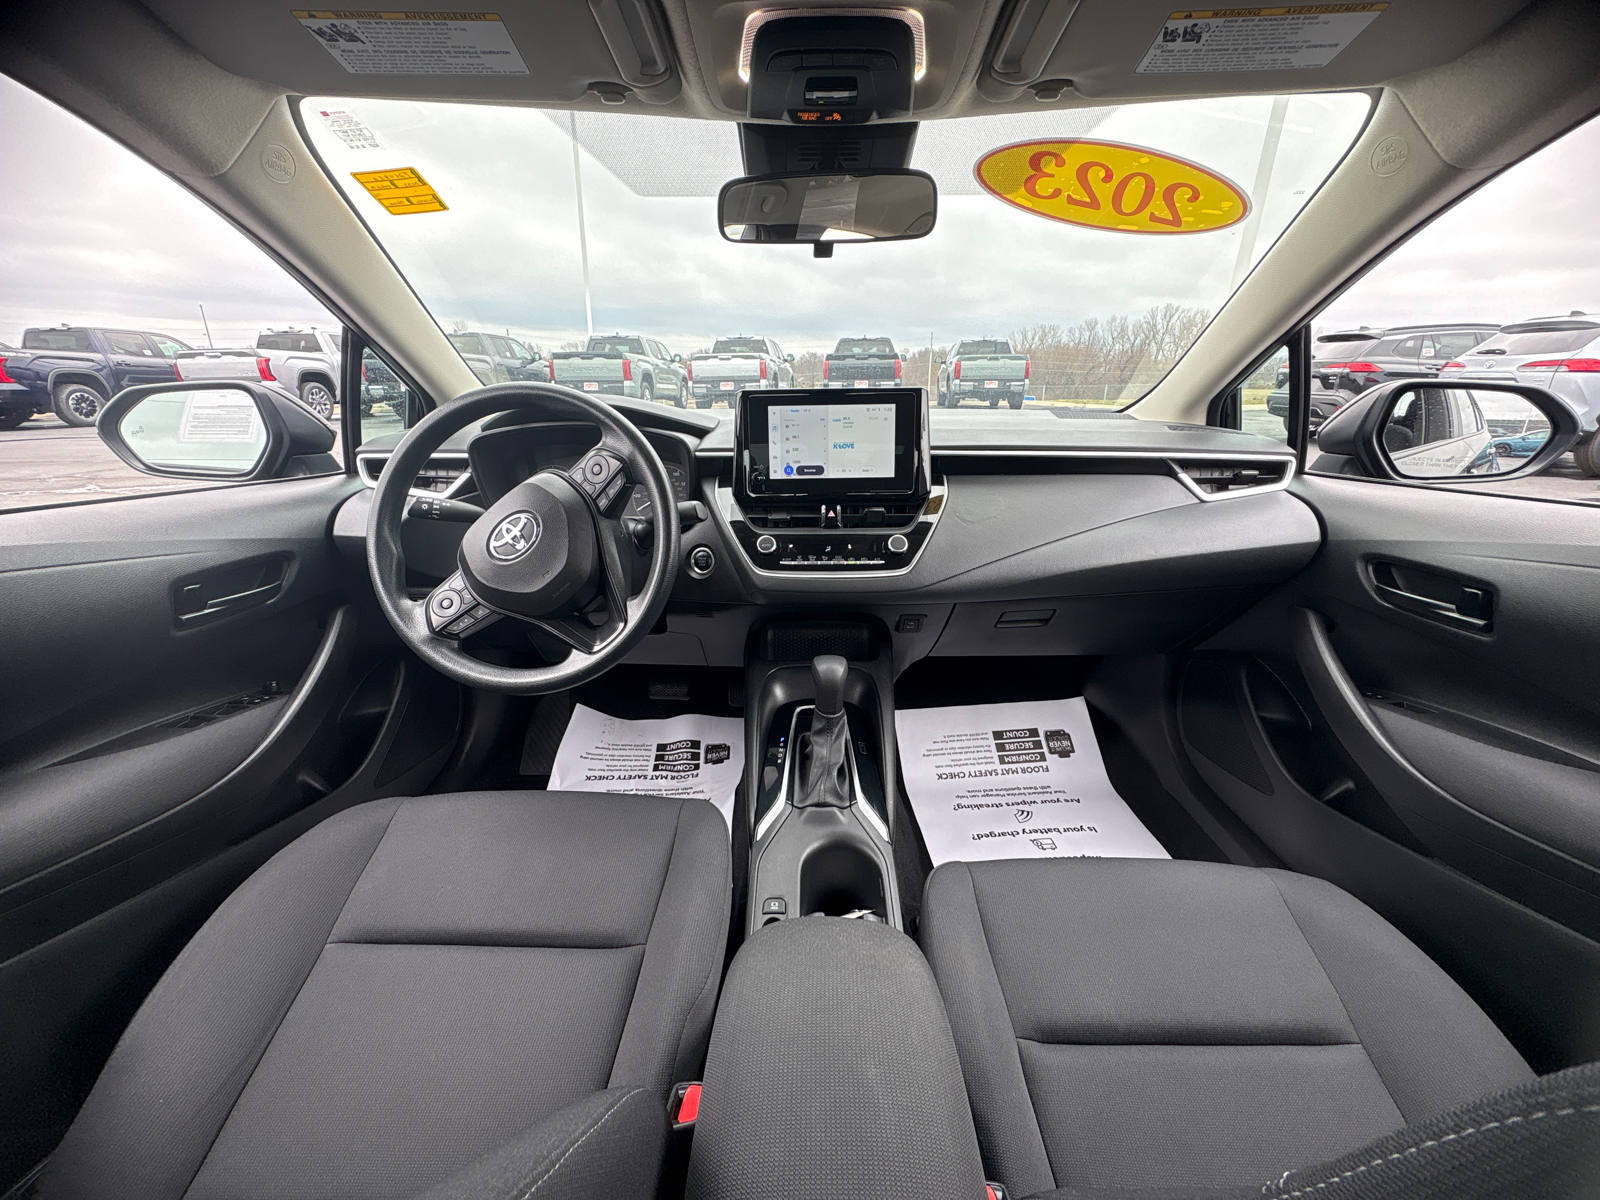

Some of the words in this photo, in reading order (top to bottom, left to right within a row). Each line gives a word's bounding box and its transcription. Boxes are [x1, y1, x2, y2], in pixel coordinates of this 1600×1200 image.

[1212, 8, 1262, 17] WARNING
[1284, 4, 1372, 14] AVERTISSEMENT
[332, 11, 383, 19] WARNING
[405, 12, 487, 20] AVERTISSEMENT
[1380, 141, 1396, 157] SRS
[272, 150, 287, 164] SRS
[1376, 149, 1405, 170] AIRBAG
[265, 158, 292, 177] AIRBAG
[568, 365, 608, 373] TUNDRA
[1002, 730, 1030, 738] COUNT
[665, 741, 692, 750] COUNT
[1004, 742, 1034, 750] SECURE
[1049, 740, 1071, 748] NEVER
[663, 752, 692, 761] SECURE
[706, 751, 728, 759] NEVER
[1004, 753, 1040, 762] CONFIRM
[967, 769, 999, 778] SAFETY
[1000, 767, 1019, 776] MAT
[1019, 765, 1050, 774] FLOOR
[670, 772, 699, 780] FLOOR
[936, 771, 966, 781] CHECK
[1005, 799, 1039, 807] wipers
[1040, 797, 1061, 805] your
[953, 802, 1004, 811] streaking?
[1021, 826, 1062, 835] battery
[1063, 825, 1087, 834] your
[1087, 826, 1098, 834] Is
[971, 830, 1020, 841] charged?
